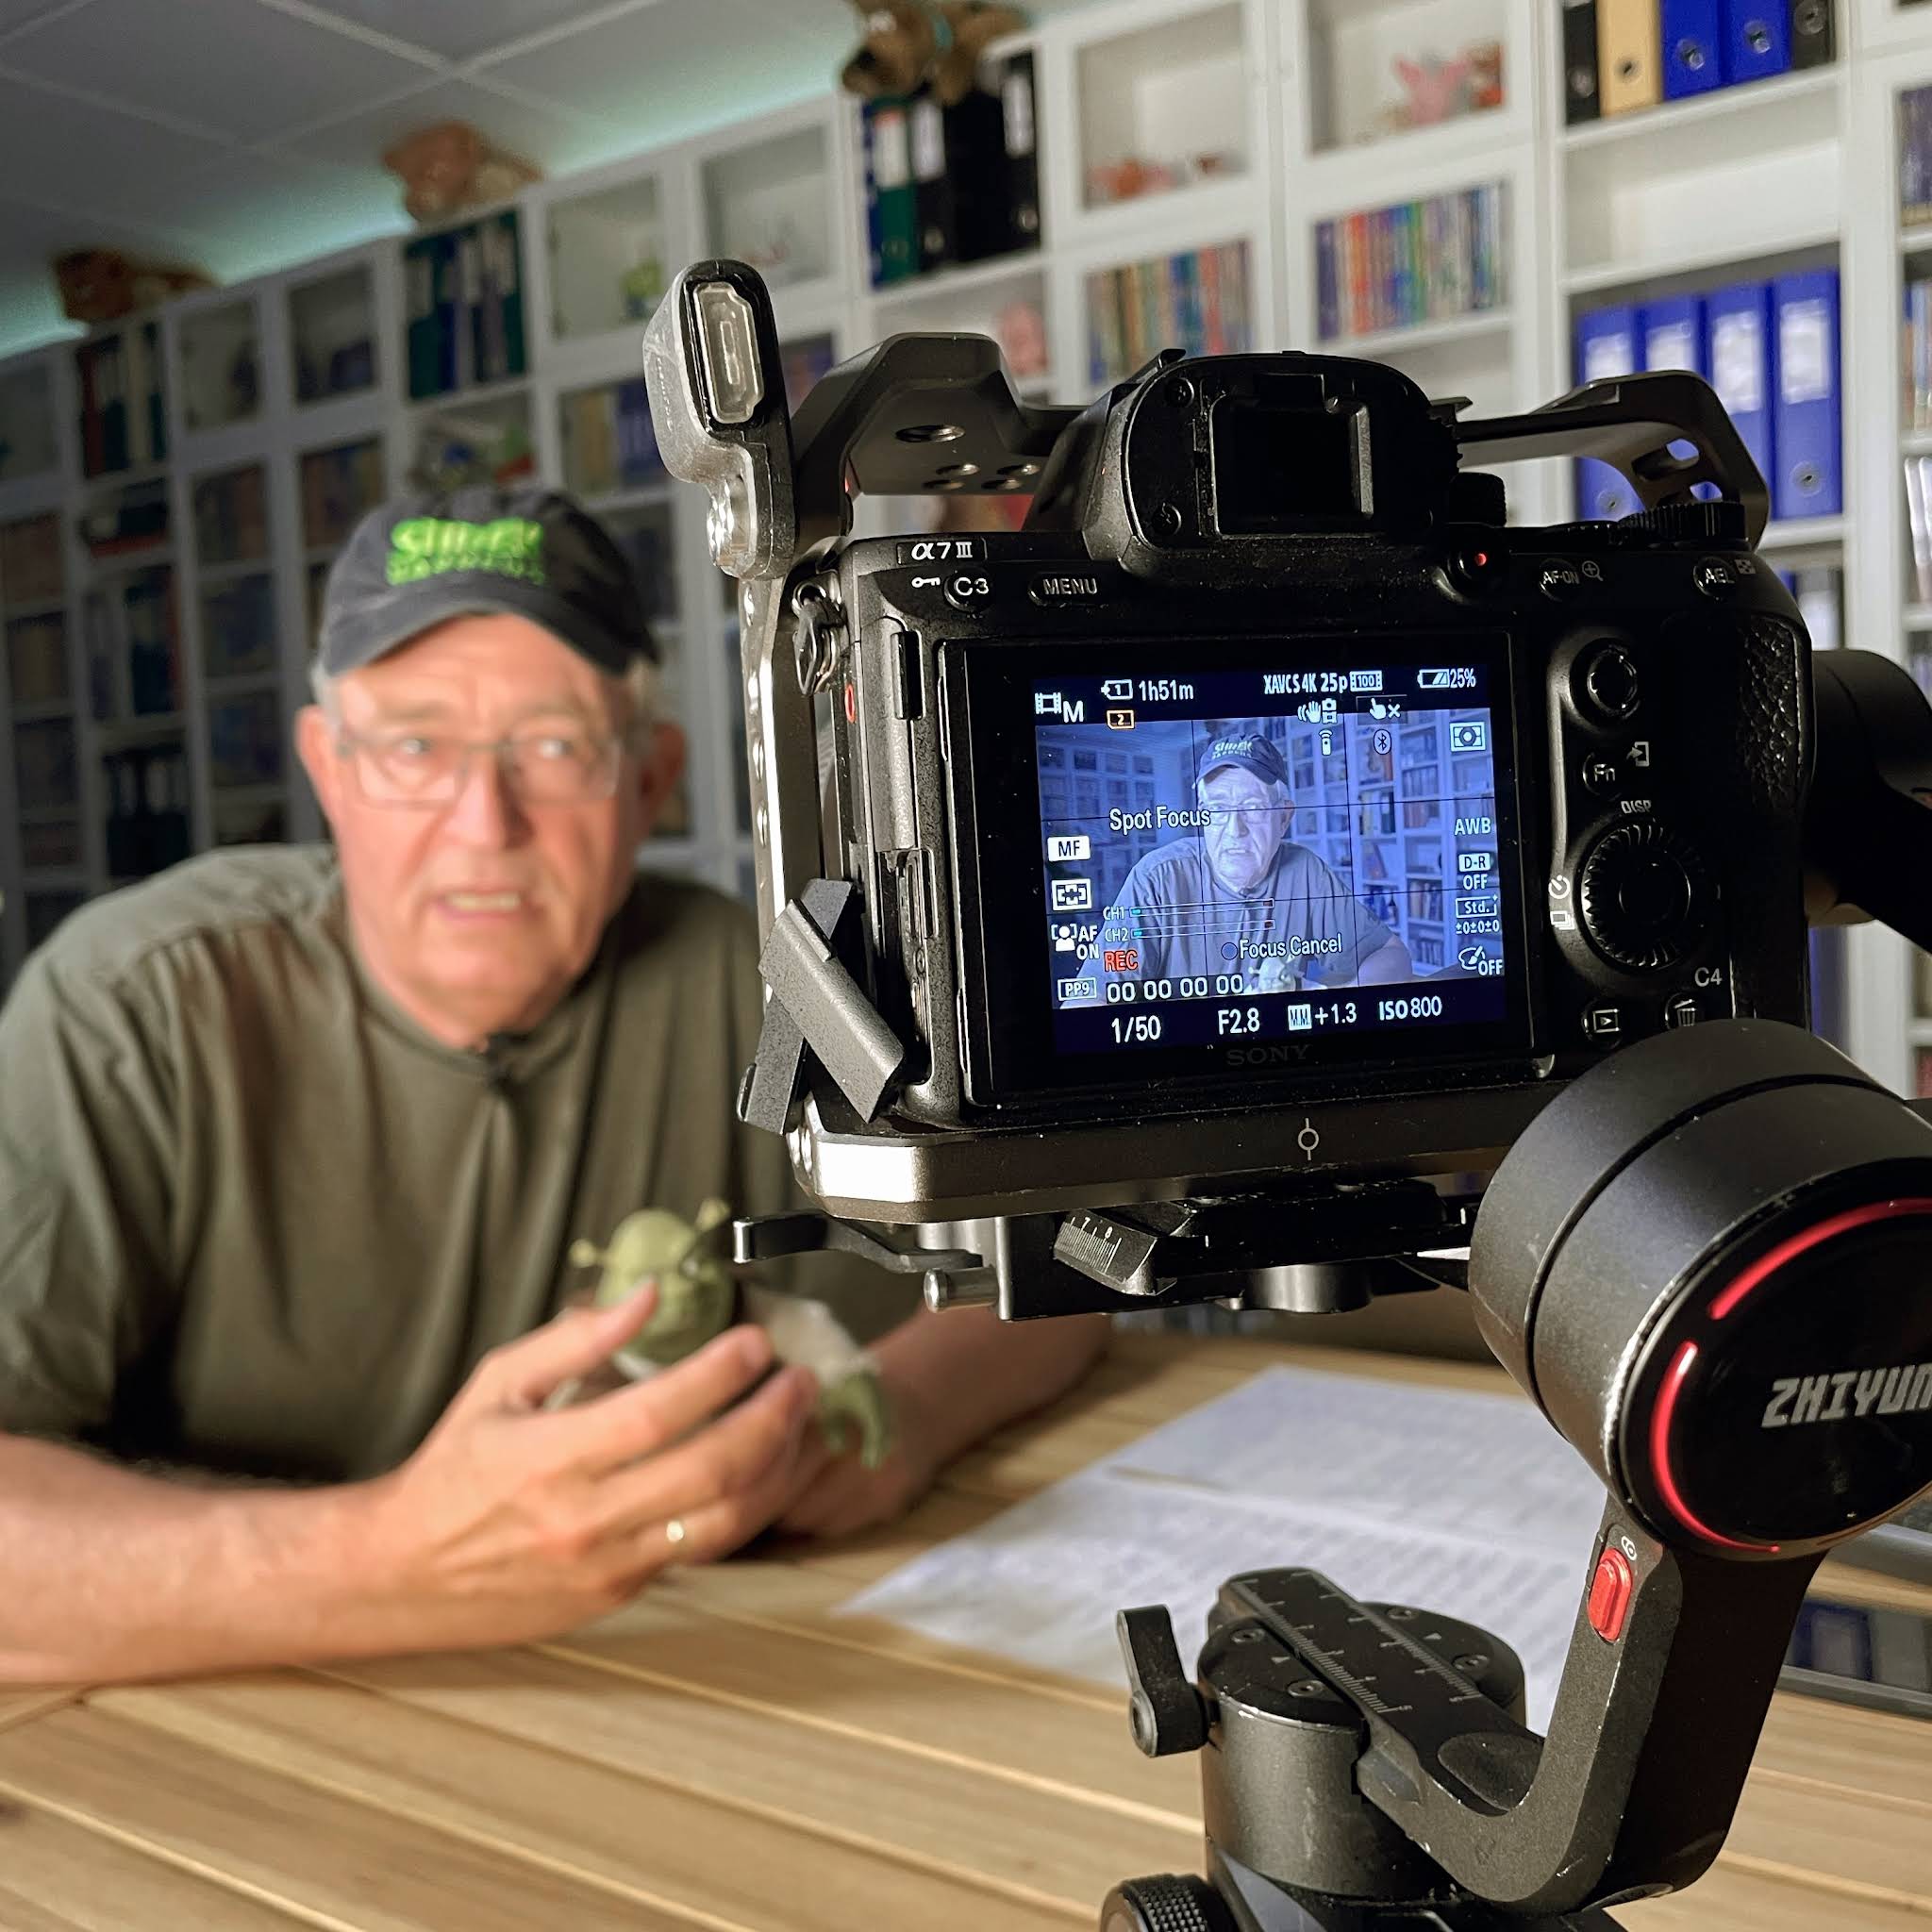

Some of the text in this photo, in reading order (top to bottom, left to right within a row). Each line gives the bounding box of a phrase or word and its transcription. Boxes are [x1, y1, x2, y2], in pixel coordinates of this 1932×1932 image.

[1705, 568, 1736, 584] AEL
[954, 576, 989, 596] C3
[1042, 577, 1097, 595] MENU
[1320, 672, 1348, 693] 25p
[1450, 668, 1476, 689] 25%
[1139, 679, 1194, 701] 1h51m
[1063, 700, 1084, 723] M
[1594, 763, 1615, 781] Fn
[1621, 799, 1652, 814] DISP
[1109, 806, 1210, 836] Spot Focus
[1454, 817, 1491, 836] AWB
[1058, 840, 1080, 858] MF
[1464, 857, 1486, 869] D-R
[1463, 874, 1488, 890] OFF
[1103, 907, 1124, 921] CH1
[1465, 902, 1491, 914] Std.
[1078, 925, 1098, 941] AF
[1105, 928, 1129, 942] CH2
[1076, 944, 1100, 960] ON
[1240, 934, 1342, 960] Focus Cancel
[1104, 951, 1139, 972] REC
[1478, 959, 1503, 975] OFF
[1695, 967, 1723, 987] C4
[1065, 982, 1091, 996] PP9
[1218, 1008, 1260, 1035] F2.8
[1314, 1003, 1357, 1025] +1.3
[1111, 1015, 1161, 1043] 1/50
[1226, 1043, 1313, 1067] SONY
[1760, 1362, 1932, 1429] ZHIYUN
